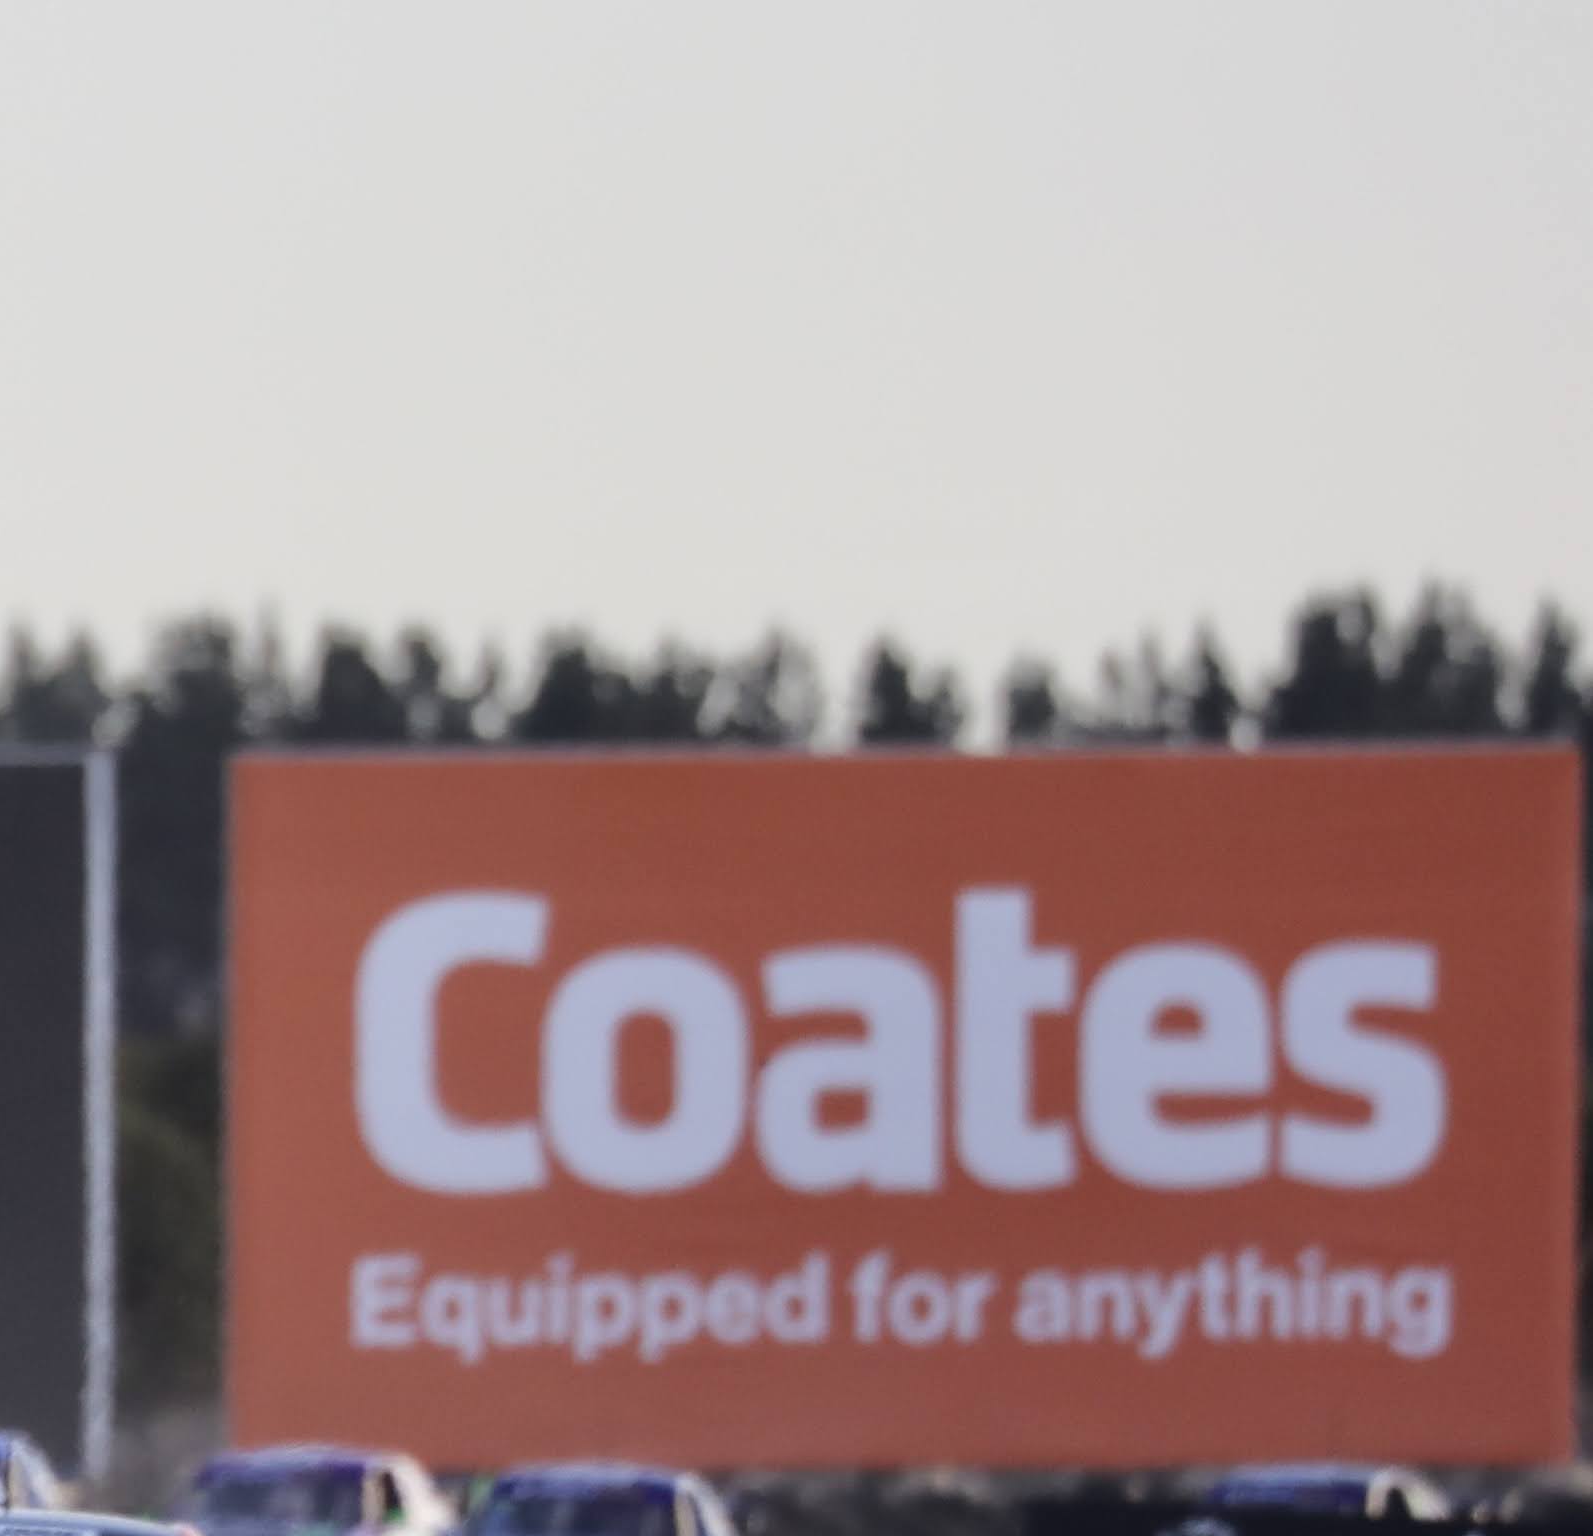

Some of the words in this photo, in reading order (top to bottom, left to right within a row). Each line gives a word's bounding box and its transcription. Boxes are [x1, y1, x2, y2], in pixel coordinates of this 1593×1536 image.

[354, 886, 1448, 1193] Coates
[350, 1253, 828, 1360] Equipped
[851, 1248, 993, 1342] for
[1013, 1248, 1452, 1360] anything
